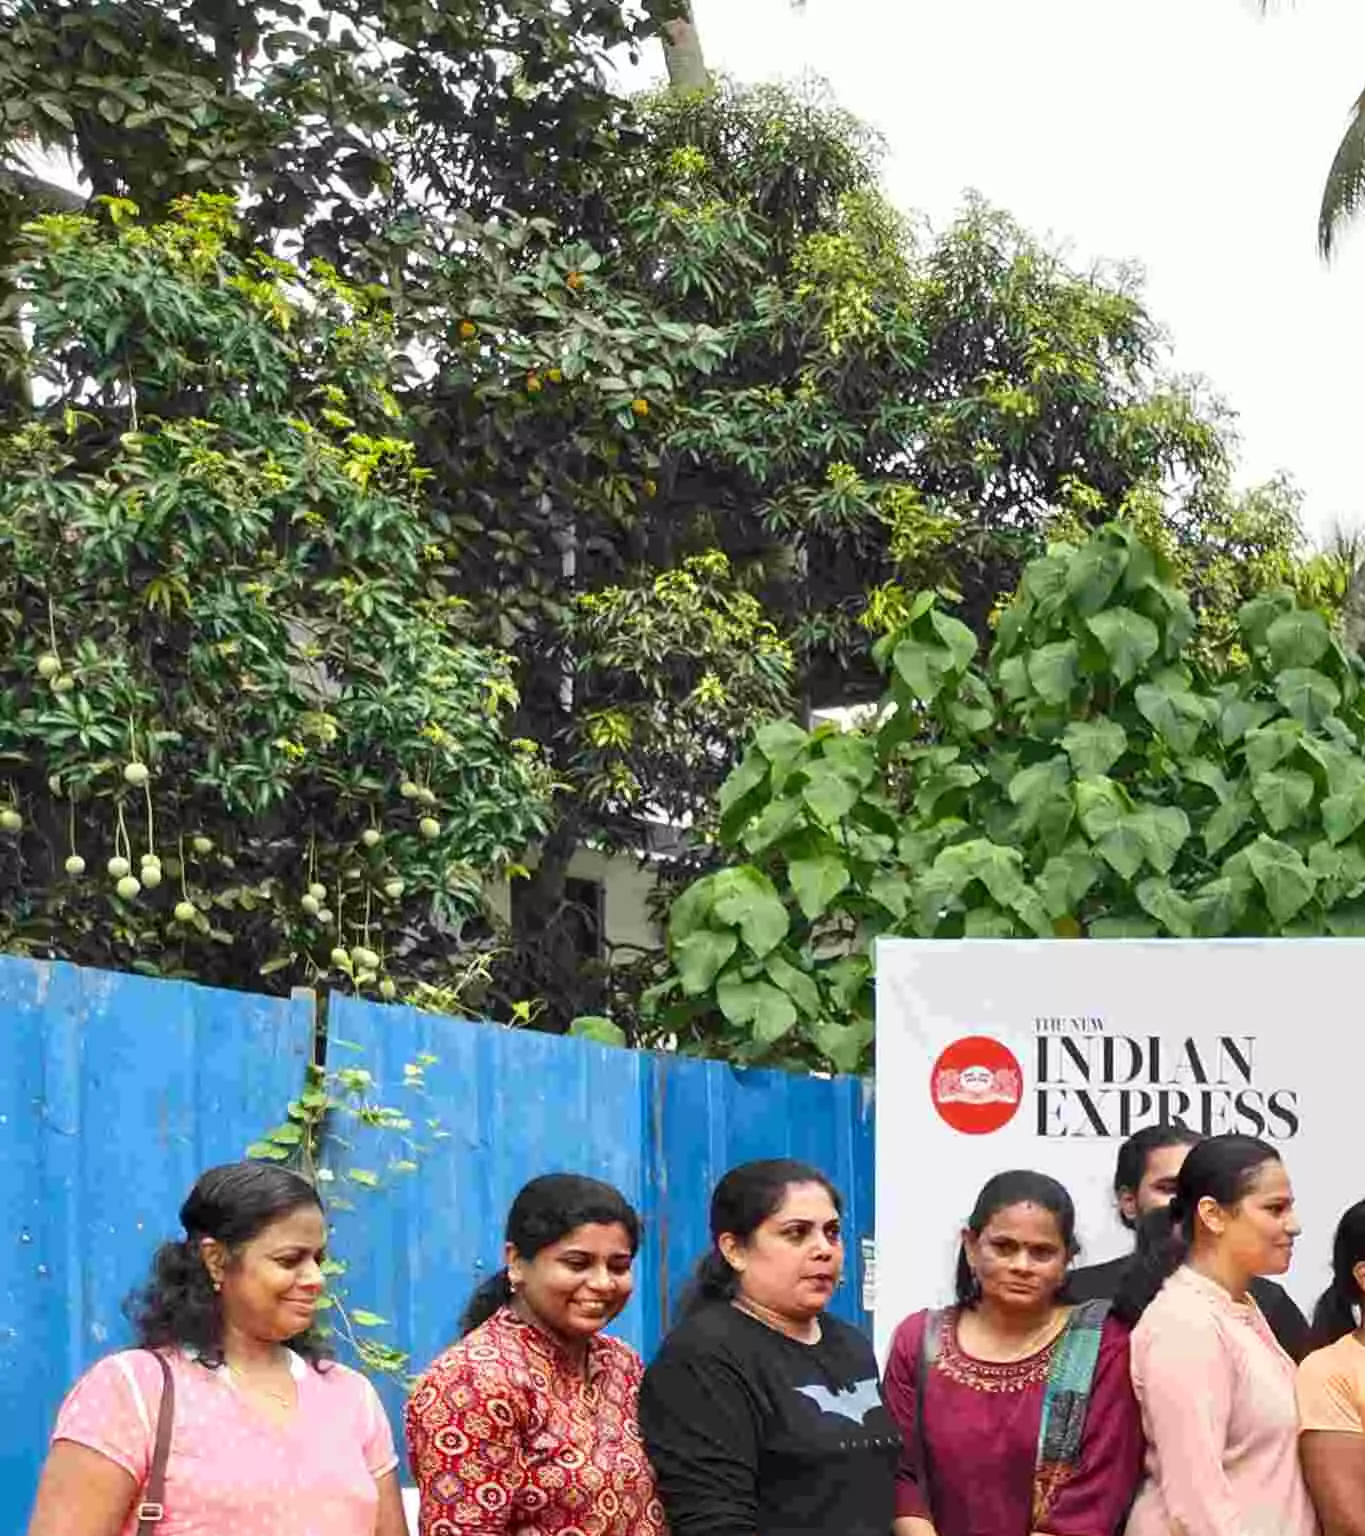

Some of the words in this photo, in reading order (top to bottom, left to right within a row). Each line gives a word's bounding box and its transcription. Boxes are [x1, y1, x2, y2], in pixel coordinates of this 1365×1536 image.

[1034, 1017, 1066, 1032] THE
[1070, 1017, 1105, 1032] NEW
[1033, 1035, 1257, 1084] INDIAN
[1033, 1088, 1300, 1139] EXPRESS
